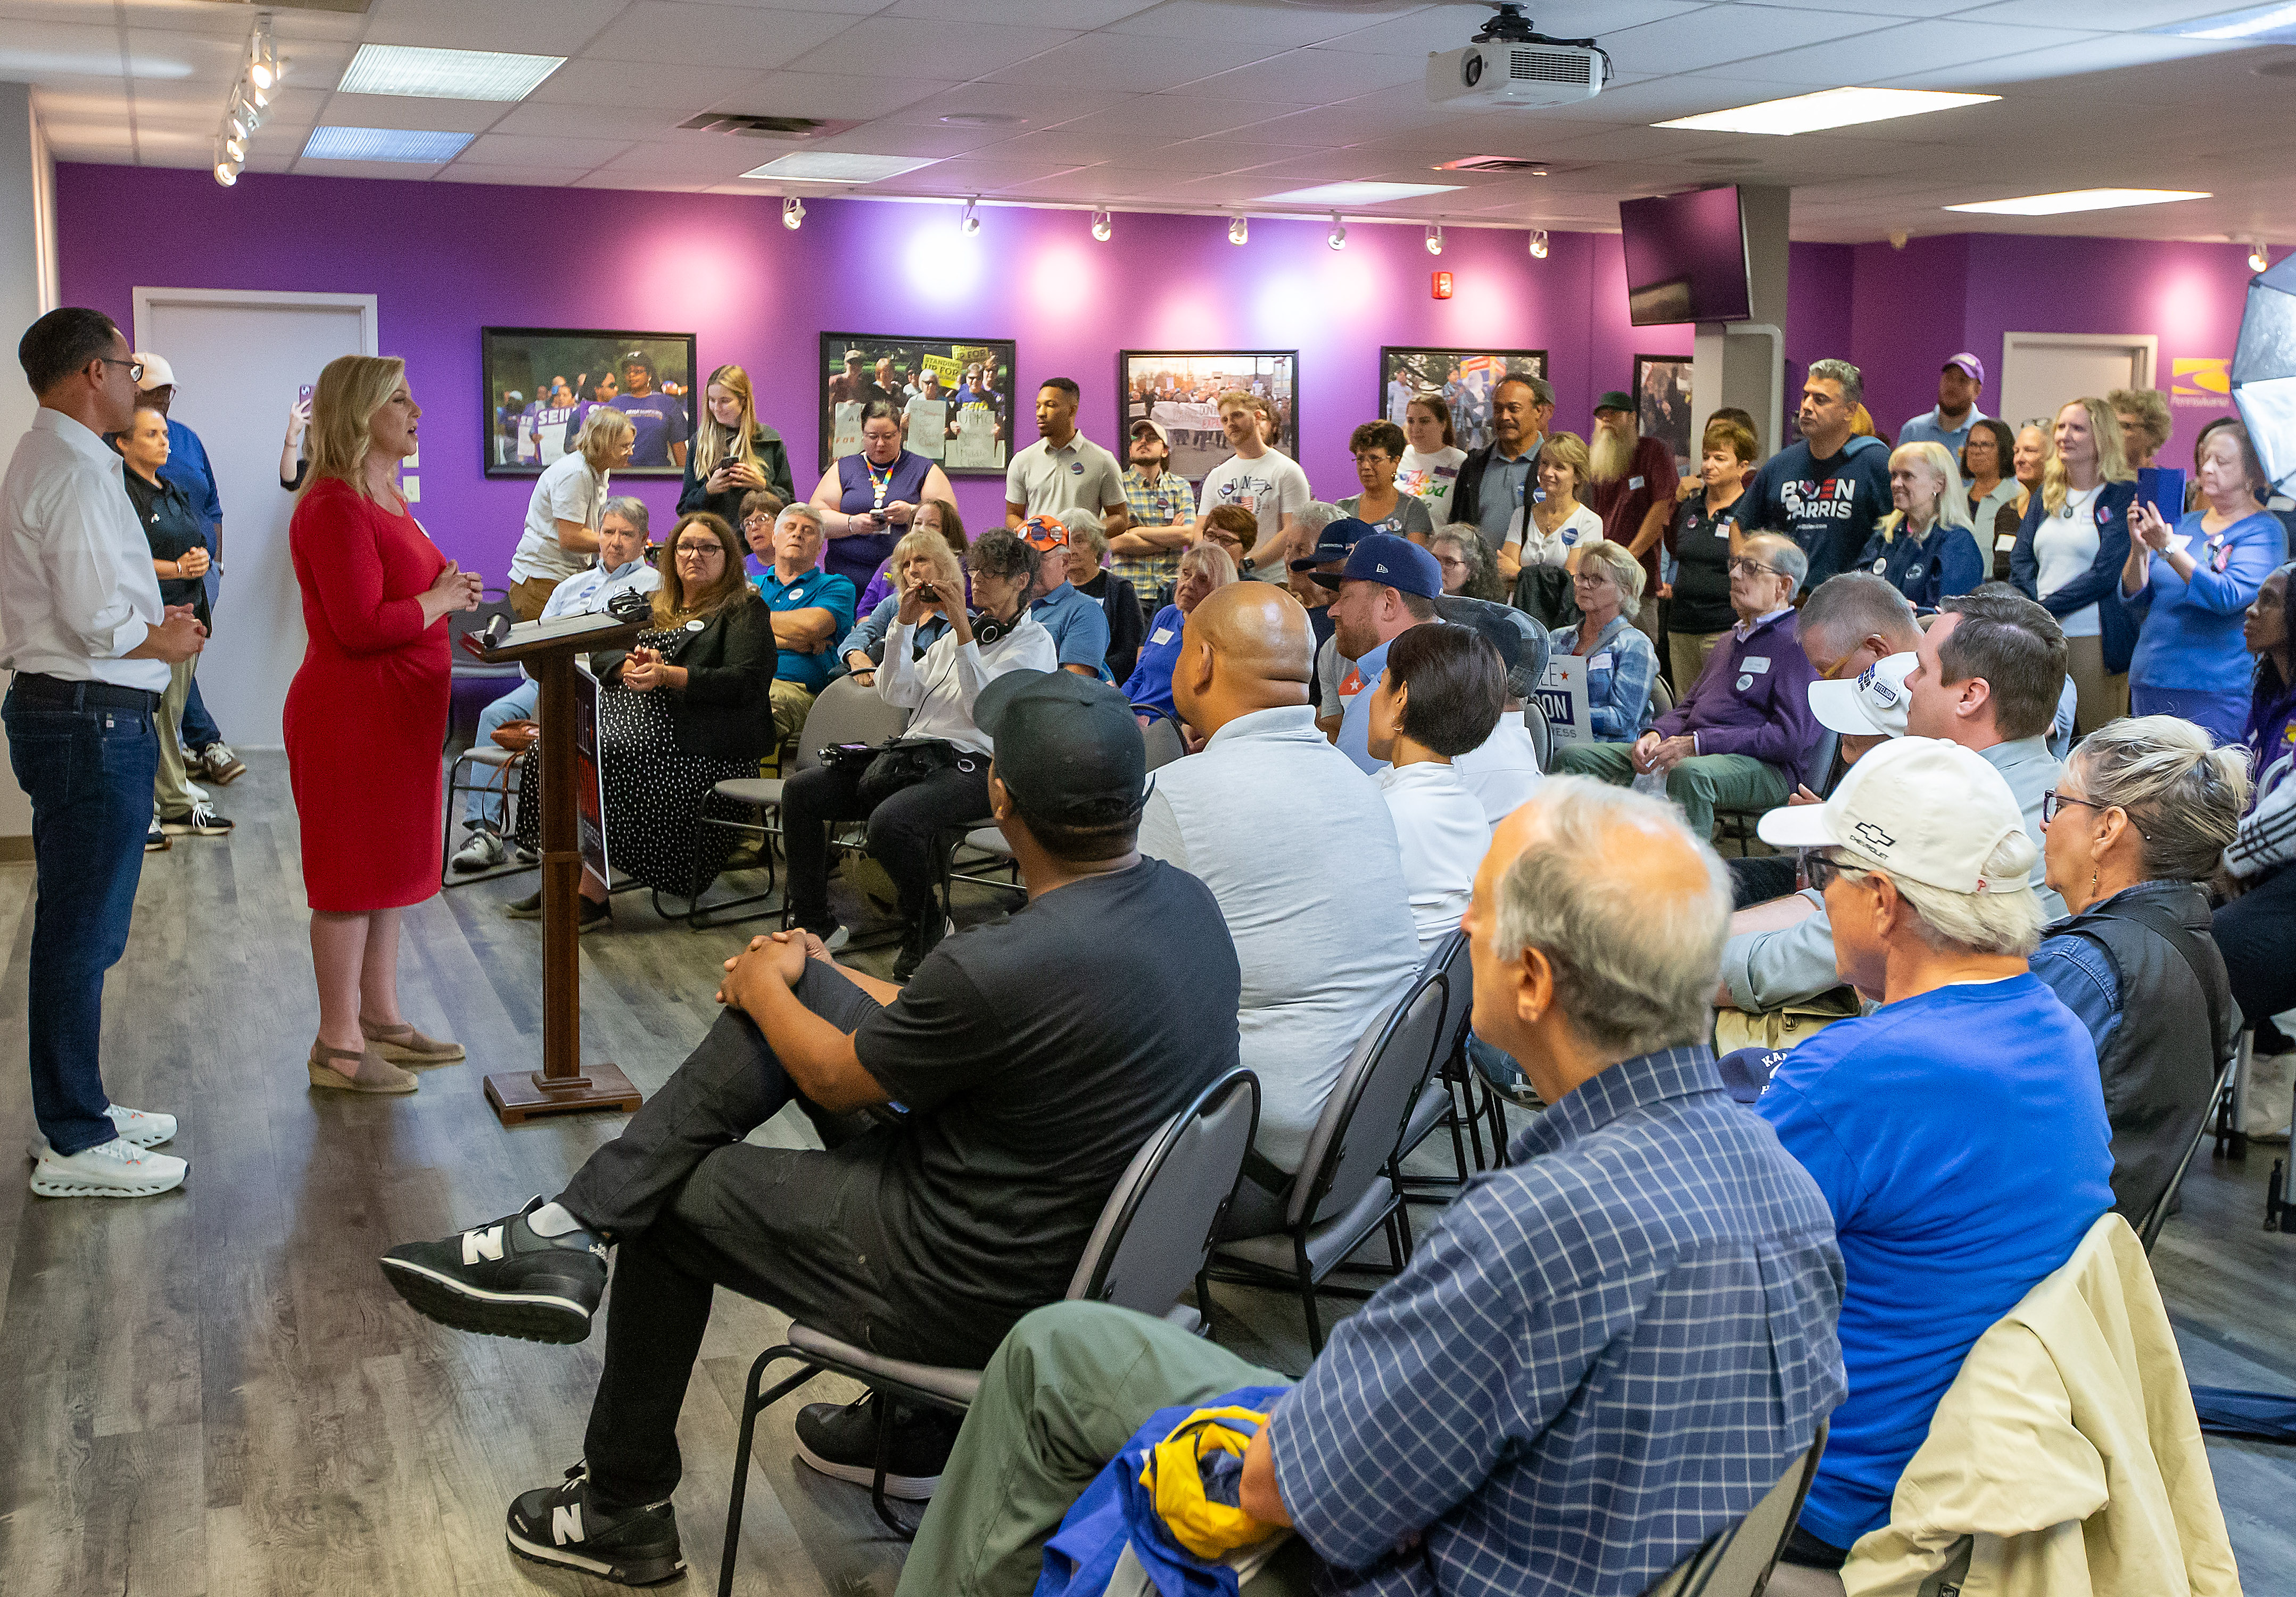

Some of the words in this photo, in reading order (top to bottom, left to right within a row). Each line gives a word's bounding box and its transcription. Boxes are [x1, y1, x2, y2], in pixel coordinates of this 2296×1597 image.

[939, 366, 959, 377] FOR
[1786, 500, 1853, 521] ARRIS
[1874, 682, 1895, 701] STELSON
